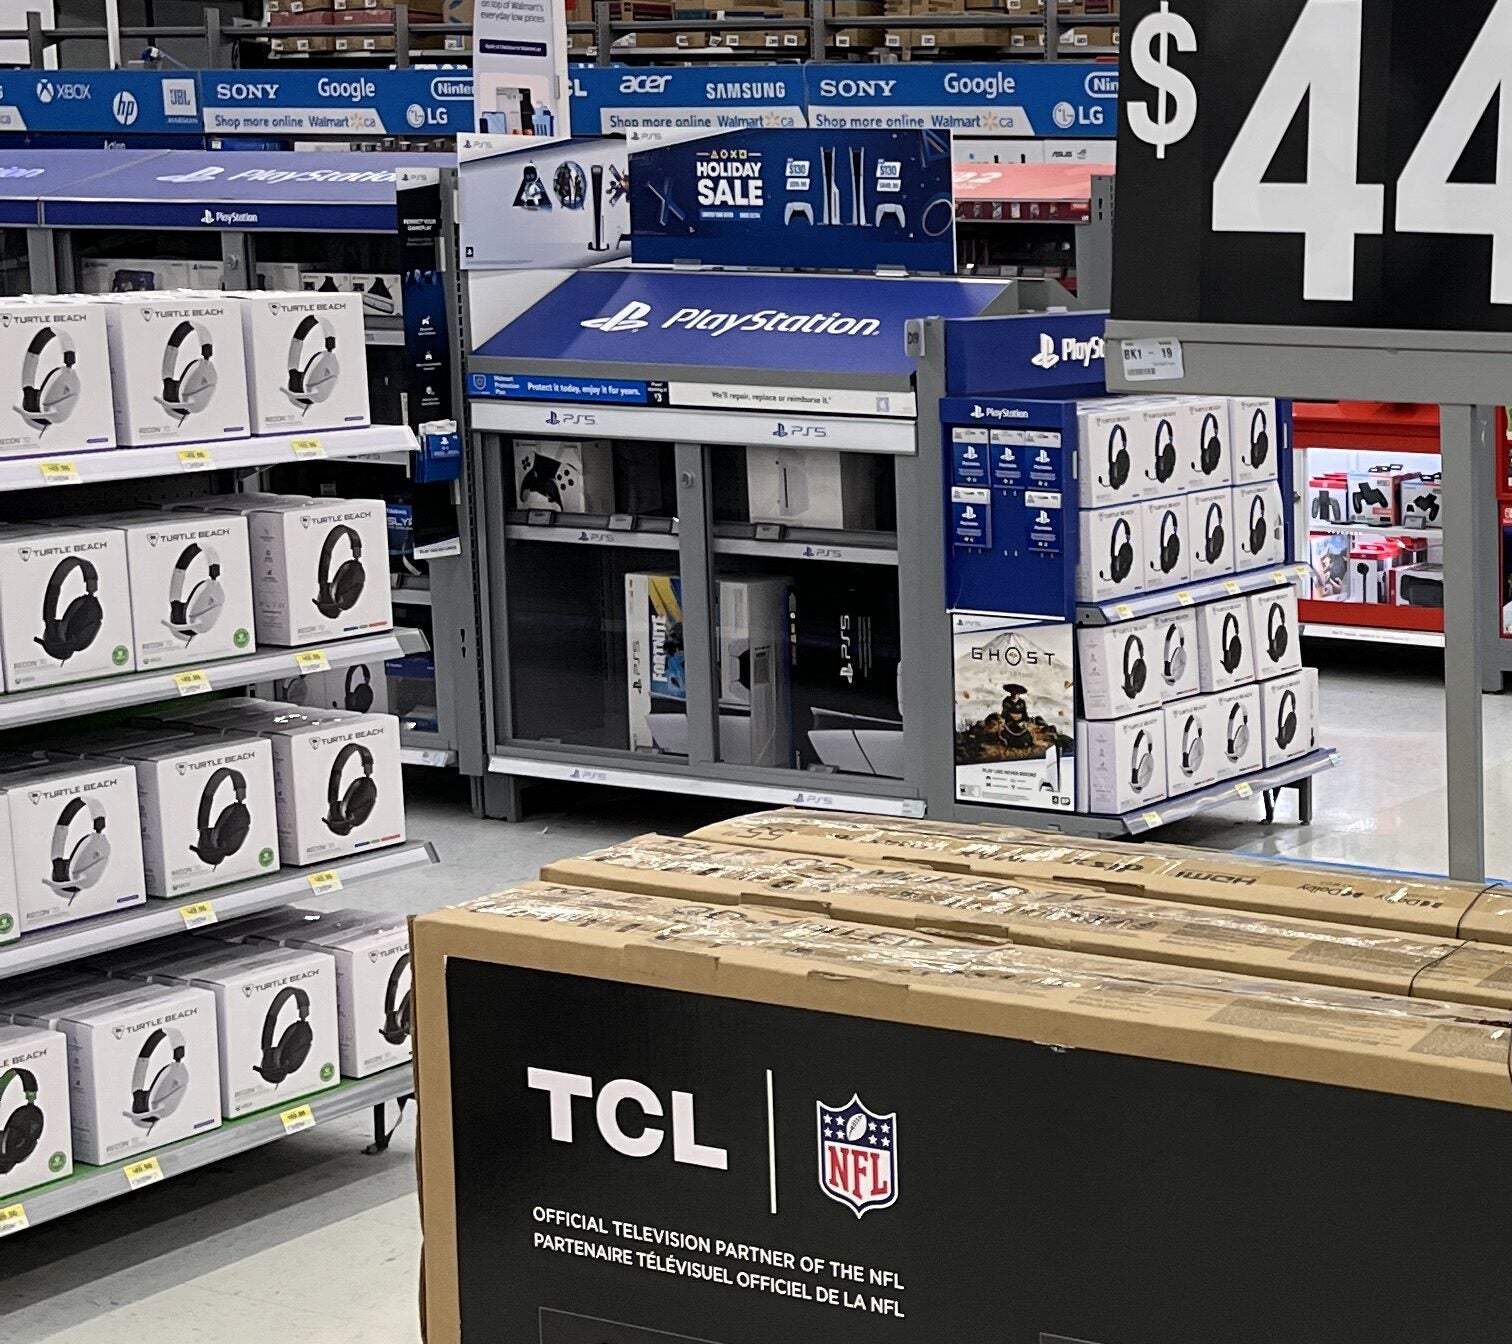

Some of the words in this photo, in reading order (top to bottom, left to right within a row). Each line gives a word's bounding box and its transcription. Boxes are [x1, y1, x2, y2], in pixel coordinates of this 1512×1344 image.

[57, 84, 91, 100] XBOX
[217, 83, 280, 100] SONY
[317, 77, 376, 102] Google
[618, 74, 673, 94] acer
[705, 81, 786, 100] SAMSUNG
[819, 79, 897, 97] SONY
[943, 70, 1016, 99] Google
[169, 88, 191, 106] JBL
[115, 92, 137, 125] hp
[427, 107, 448, 125] LG
[1078, 106, 1104, 125] LG
[214, 114, 241, 130] Shop
[243, 117, 270, 128] more
[272, 115, 304, 128] online
[308, 115, 350, 128] Walmart
[695, 160, 762, 178] HOLIDAY
[697, 178, 764, 207] SALE
[154, 309, 191, 319] TURTLE
[192, 307, 224, 317] BEACH
[661, 306, 881, 337] PlayStation
[1123, 347, 1144, 361] BK1
[1161, 346, 1174, 360] 19
[562, 413, 597, 426] PS5
[985, 406, 1029, 420] PlayStation
[791, 425, 827, 438] PS5
[33, 544, 71, 557] TURTLE
[73, 540, 108, 553] BEACH
[651, 613, 667, 683] FORTNITE
[971, 645, 1056, 666] GHOST
[188, 759, 223, 772] TURTLE
[225, 751, 256, 764] BEACH
[254, 981, 289, 993] TURTLE
[289, 968, 320, 982] BEACH
[526, 1066, 729, 1171] TCL
[826, 1144, 889, 1201] NFL
[532, 1206, 609, 1235] OFFICIAL
[612, 1220, 711, 1254] TELEVISION
[715, 1240, 796, 1270] PARTNER
[799, 1255, 825, 1274] OF
[829, 1261, 865, 1284] THE
[869, 1268, 905, 1291] NFL
[533, 1232, 634, 1268] PARTENAIRE
[636, 1248, 734, 1287] TÉLÉVISUEL
[736, 1271, 813, 1301] OFFICIEL
[815, 1286, 840, 1306] DE
[843, 1291, 868, 1312] LA
[870, 1298, 905, 1318] NFL
